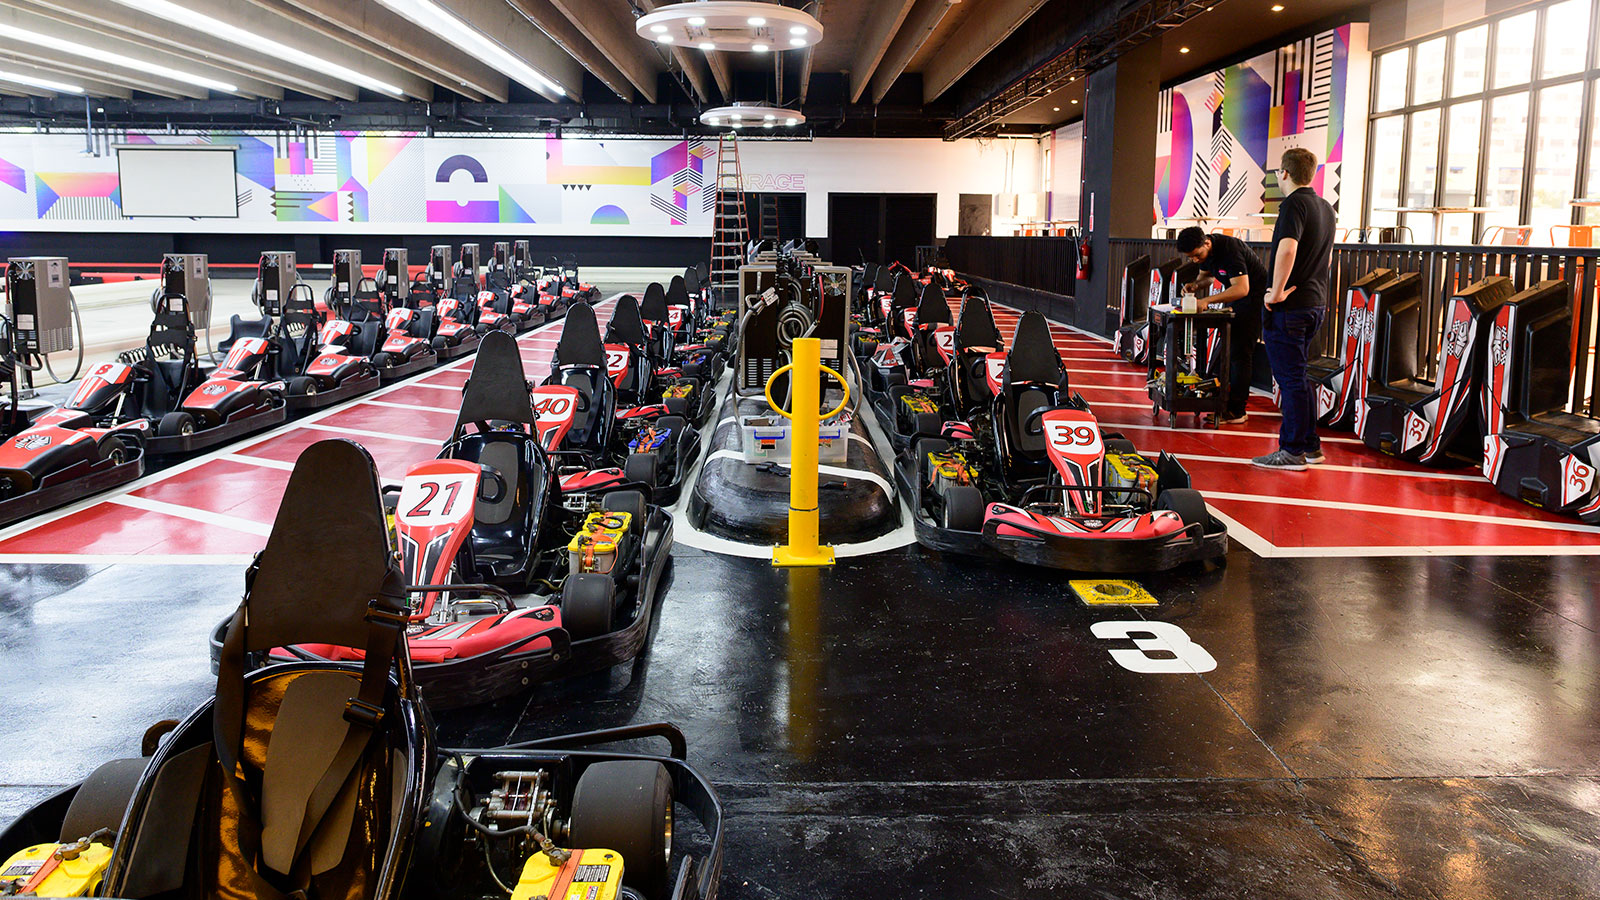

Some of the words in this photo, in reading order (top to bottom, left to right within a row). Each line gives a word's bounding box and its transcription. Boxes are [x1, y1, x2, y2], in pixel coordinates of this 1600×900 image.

[943, 334, 953, 347] 2
[95, 364, 114, 375] 8
[535, 398, 570, 415] 40
[1054, 425, 1095, 446] 39
[1408, 418, 1426, 442] 39
[1569, 461, 1590, 493] 36
[406, 481, 463, 518] 21
[1089, 620, 1218, 674] 3
